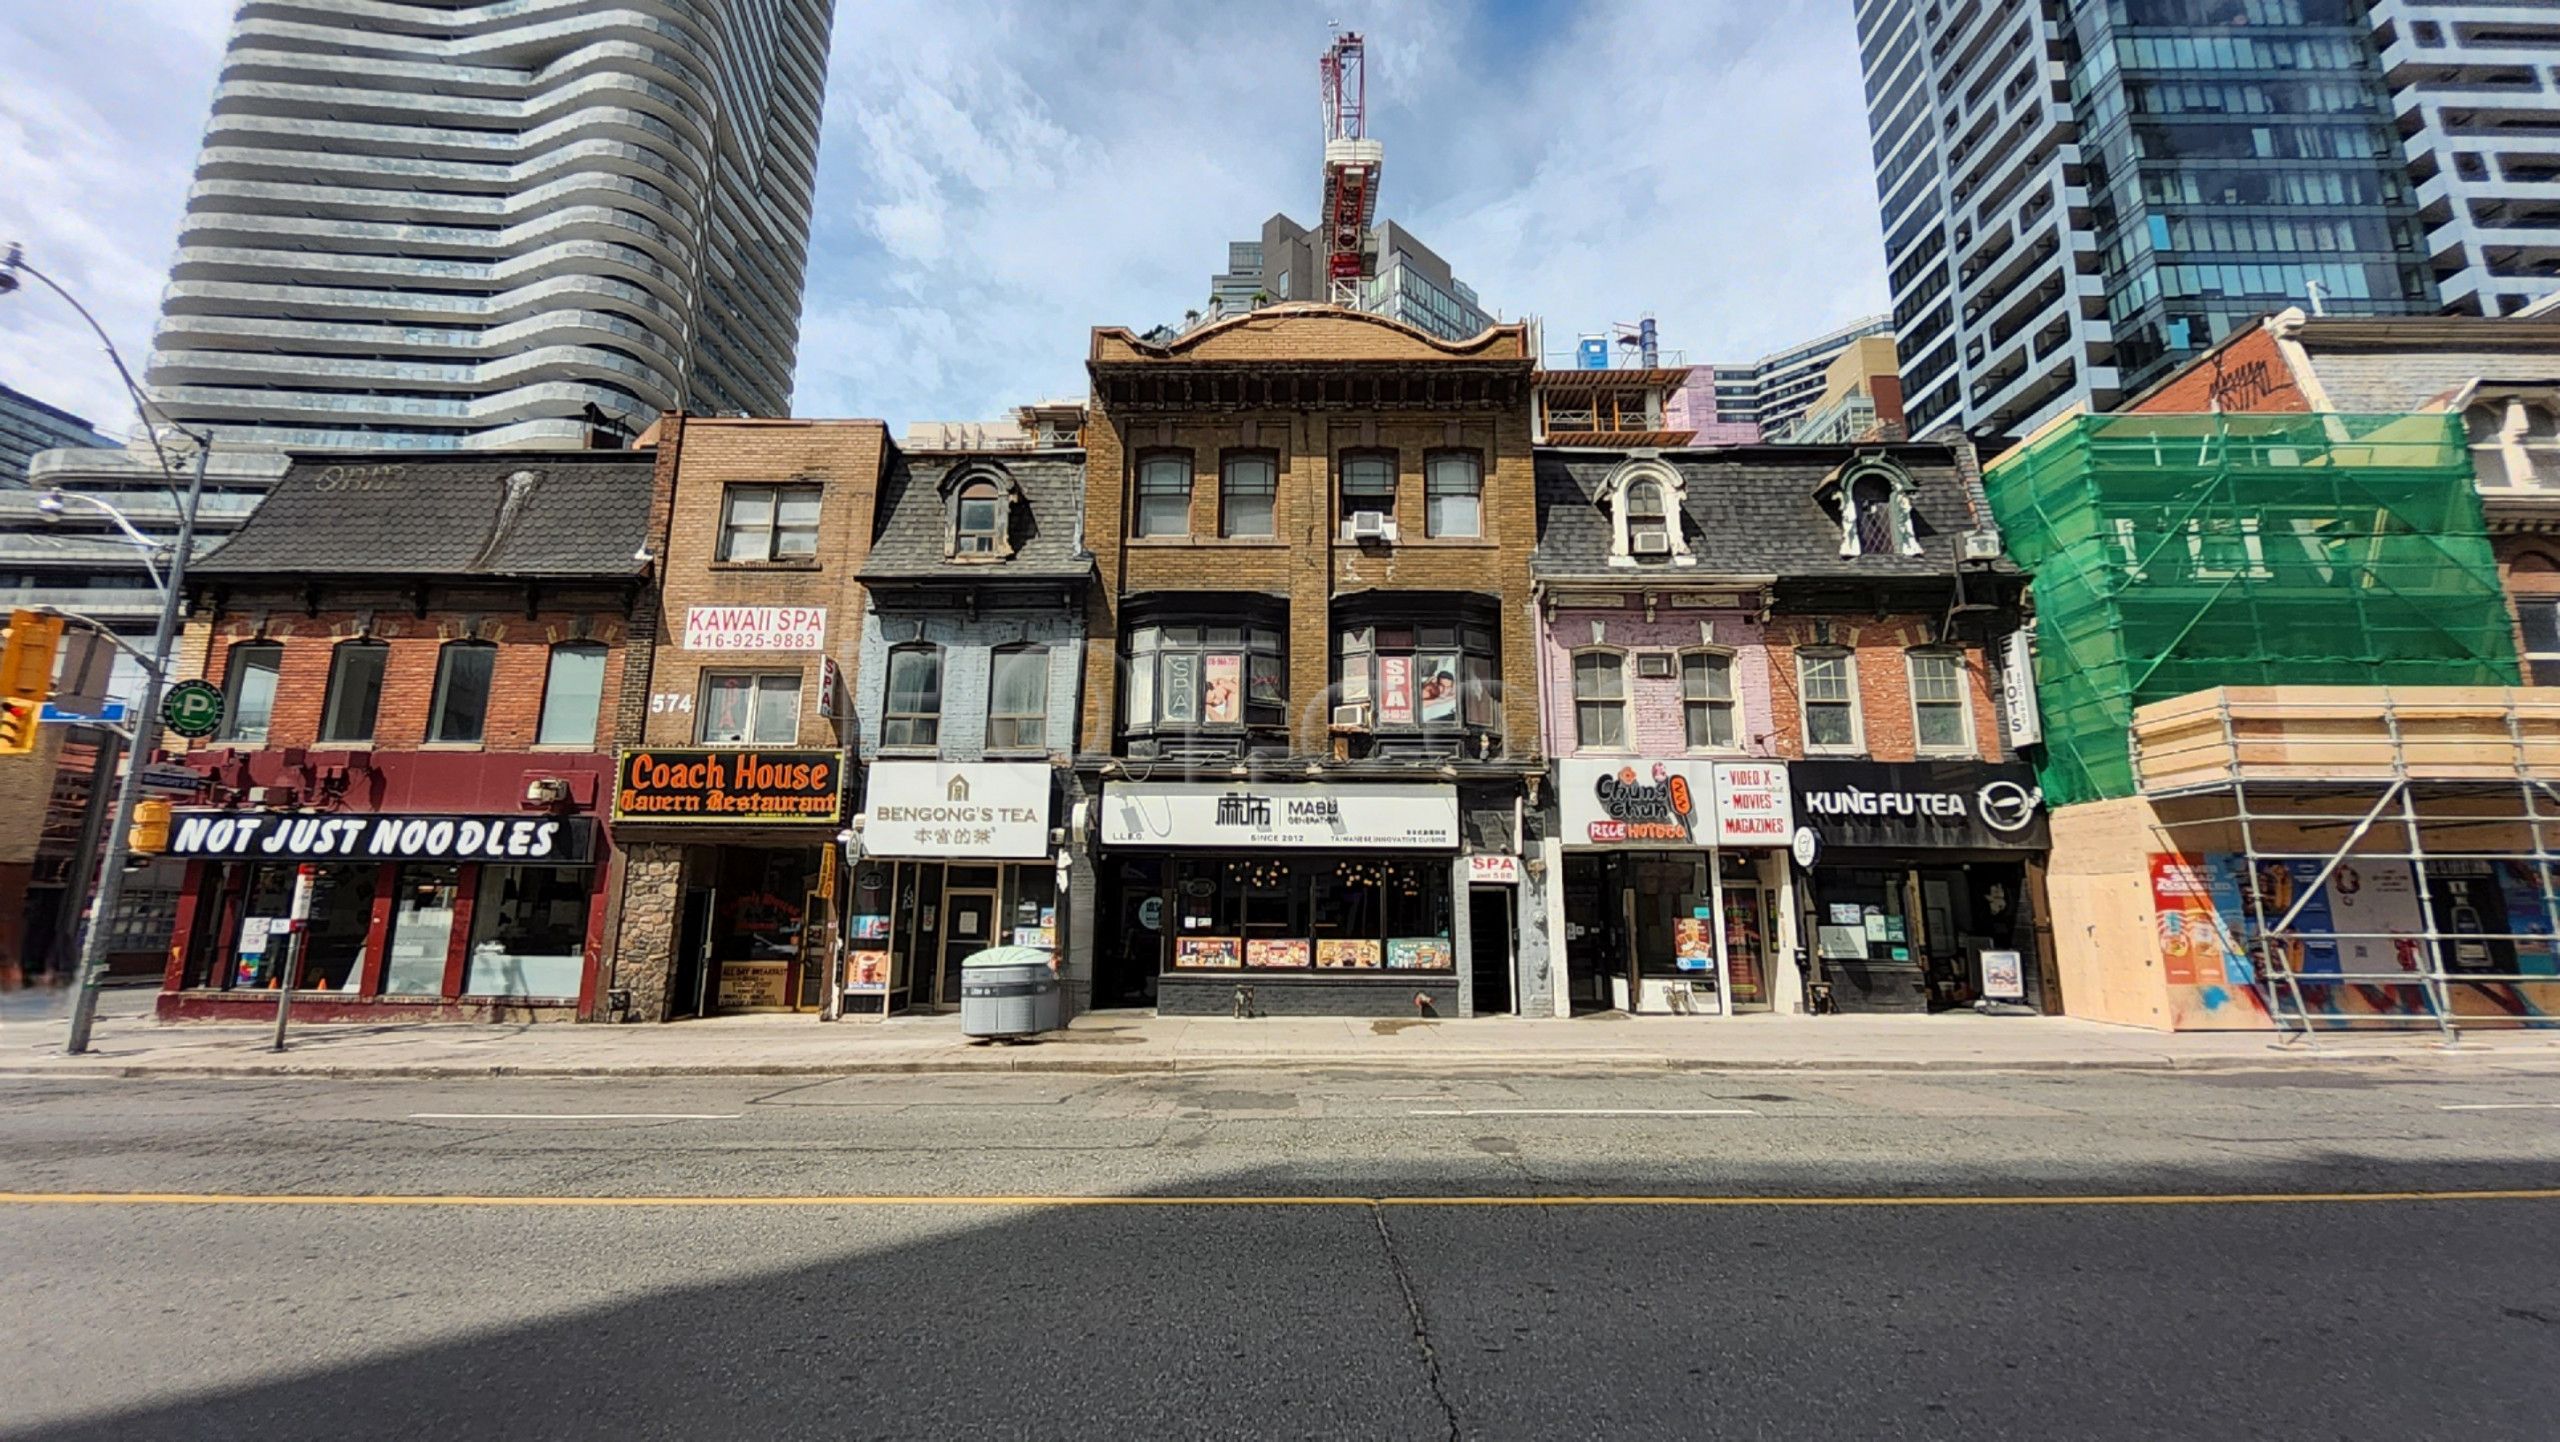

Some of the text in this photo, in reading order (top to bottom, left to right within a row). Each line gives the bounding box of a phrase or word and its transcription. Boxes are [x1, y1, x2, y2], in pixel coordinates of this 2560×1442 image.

[690, 610, 822, 631] KAWAII SPA
[692, 633, 816, 648] 416-925-9883
[822, 658, 834, 708] SPA
[1384, 659, 1407, 707] SPA
[182, 693, 209, 717] P
[652, 694, 692, 714] 574
[631, 752, 829, 791] Coach House
[1728, 768, 1772, 786] VIDEO X
[1596, 773, 1668, 800] Chung
[620, 789, 837, 813] Tavern Restaurant
[1287, 801, 1339, 815] MABU
[1732, 793, 1772, 810] MOVIES
[1805, 788, 1967, 816] KUNG FU TEA
[876, 805, 1039, 823] BENGONG'S TEA
[1590, 822, 1626, 838] RICE
[1724, 818, 1785, 834] MAGAZINES
[173, 817, 560, 856] NOT JUST NOODLES
[1250, 834, 1304, 842] SINCE 2012
[1471, 857, 1515, 870] SPA
